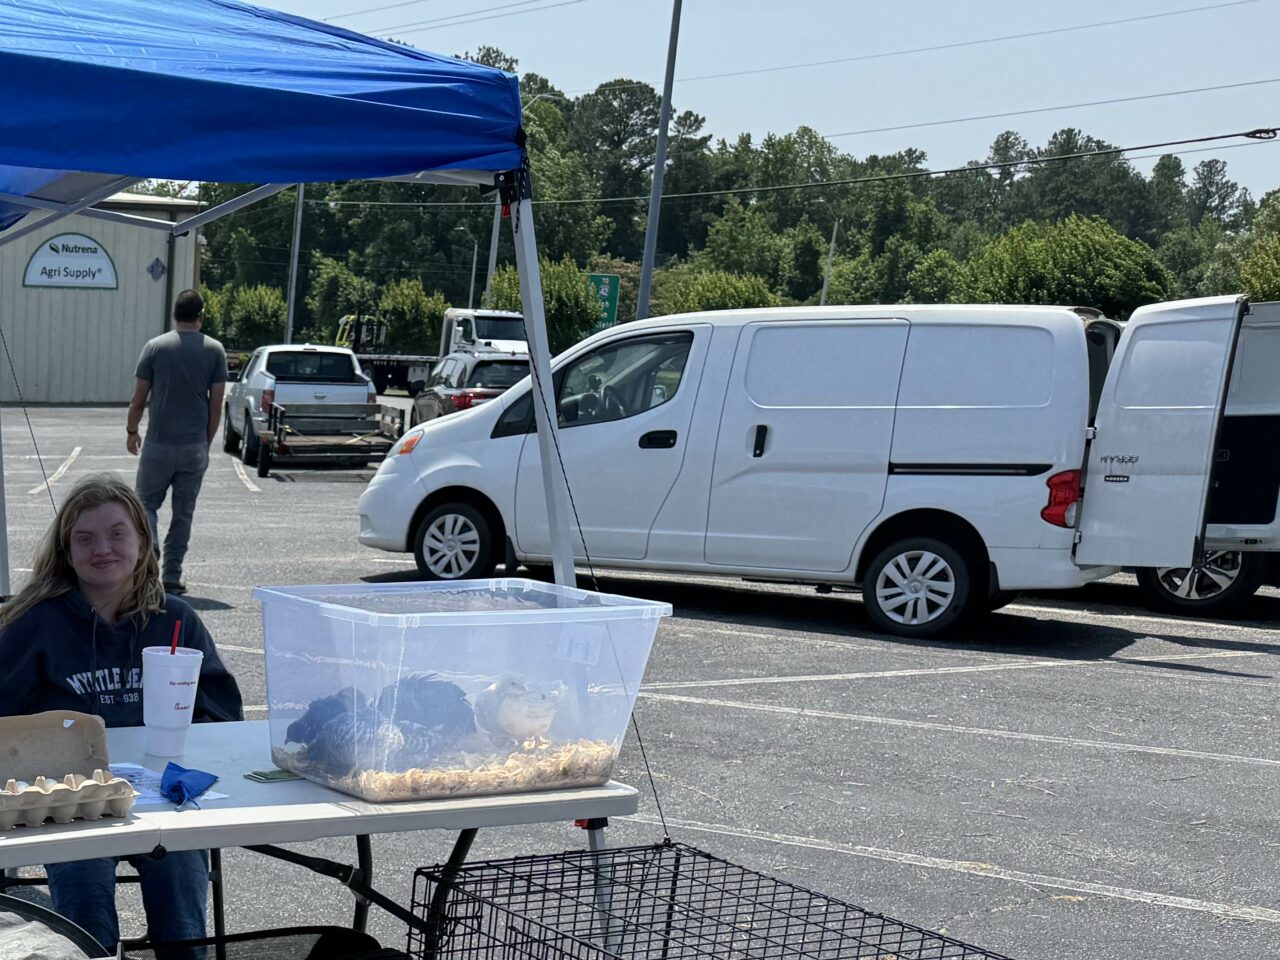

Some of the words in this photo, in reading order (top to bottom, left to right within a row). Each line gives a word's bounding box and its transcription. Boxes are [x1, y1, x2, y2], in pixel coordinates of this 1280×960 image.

[61, 243, 98, 254] Nutrena
[40, 266, 61, 279] Agri
[122, 692, 140, 703] 938
